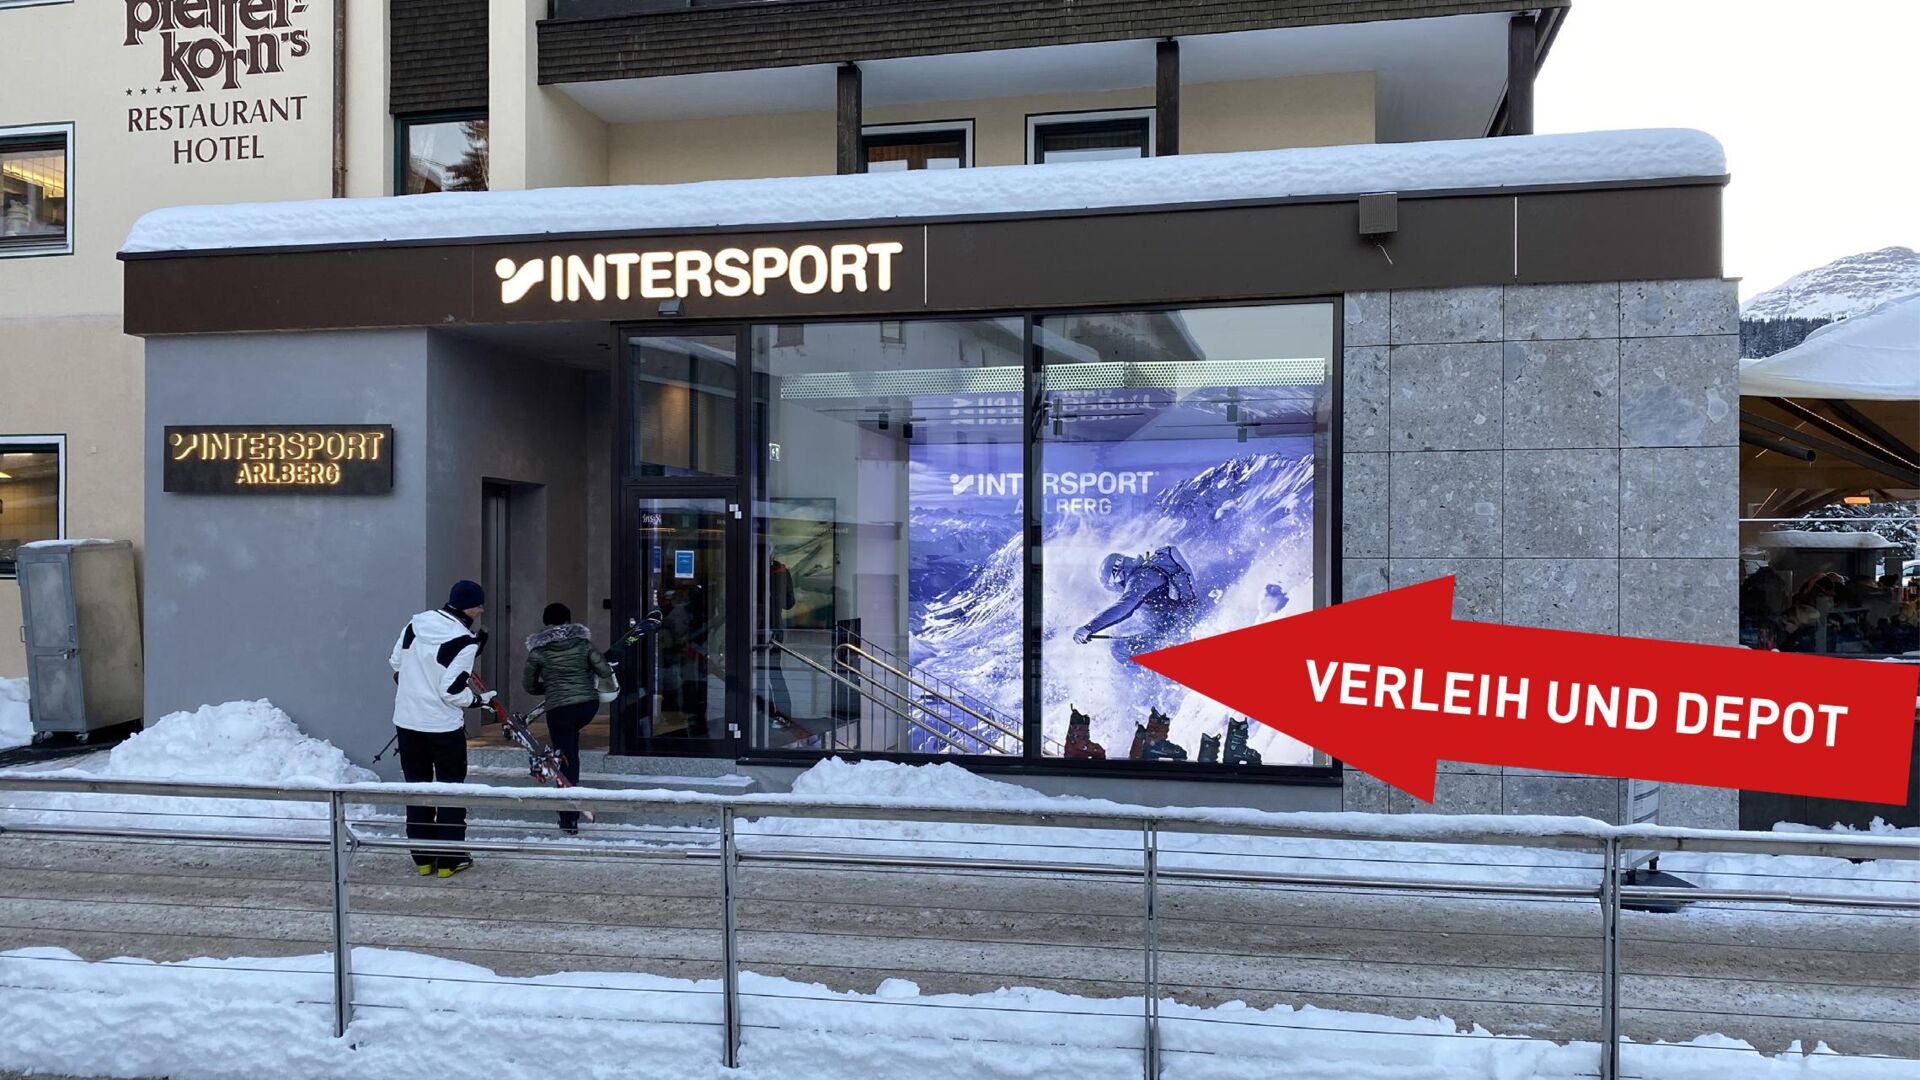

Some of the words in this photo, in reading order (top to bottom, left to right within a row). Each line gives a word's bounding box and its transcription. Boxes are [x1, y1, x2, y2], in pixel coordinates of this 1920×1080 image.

[159, 29, 311, 93] korn's
[128, 95, 308, 133] RESTAURANT
[173, 134, 265, 165] HOTEL
[550, 241, 904, 303] INTERSPORT
[200, 432, 386, 461] INTERSPORT
[234, 462, 342, 485] ARLBERG
[977, 471, 1155, 496] INTRSPORT
[1013, 498, 1113, 515] ALBERG
